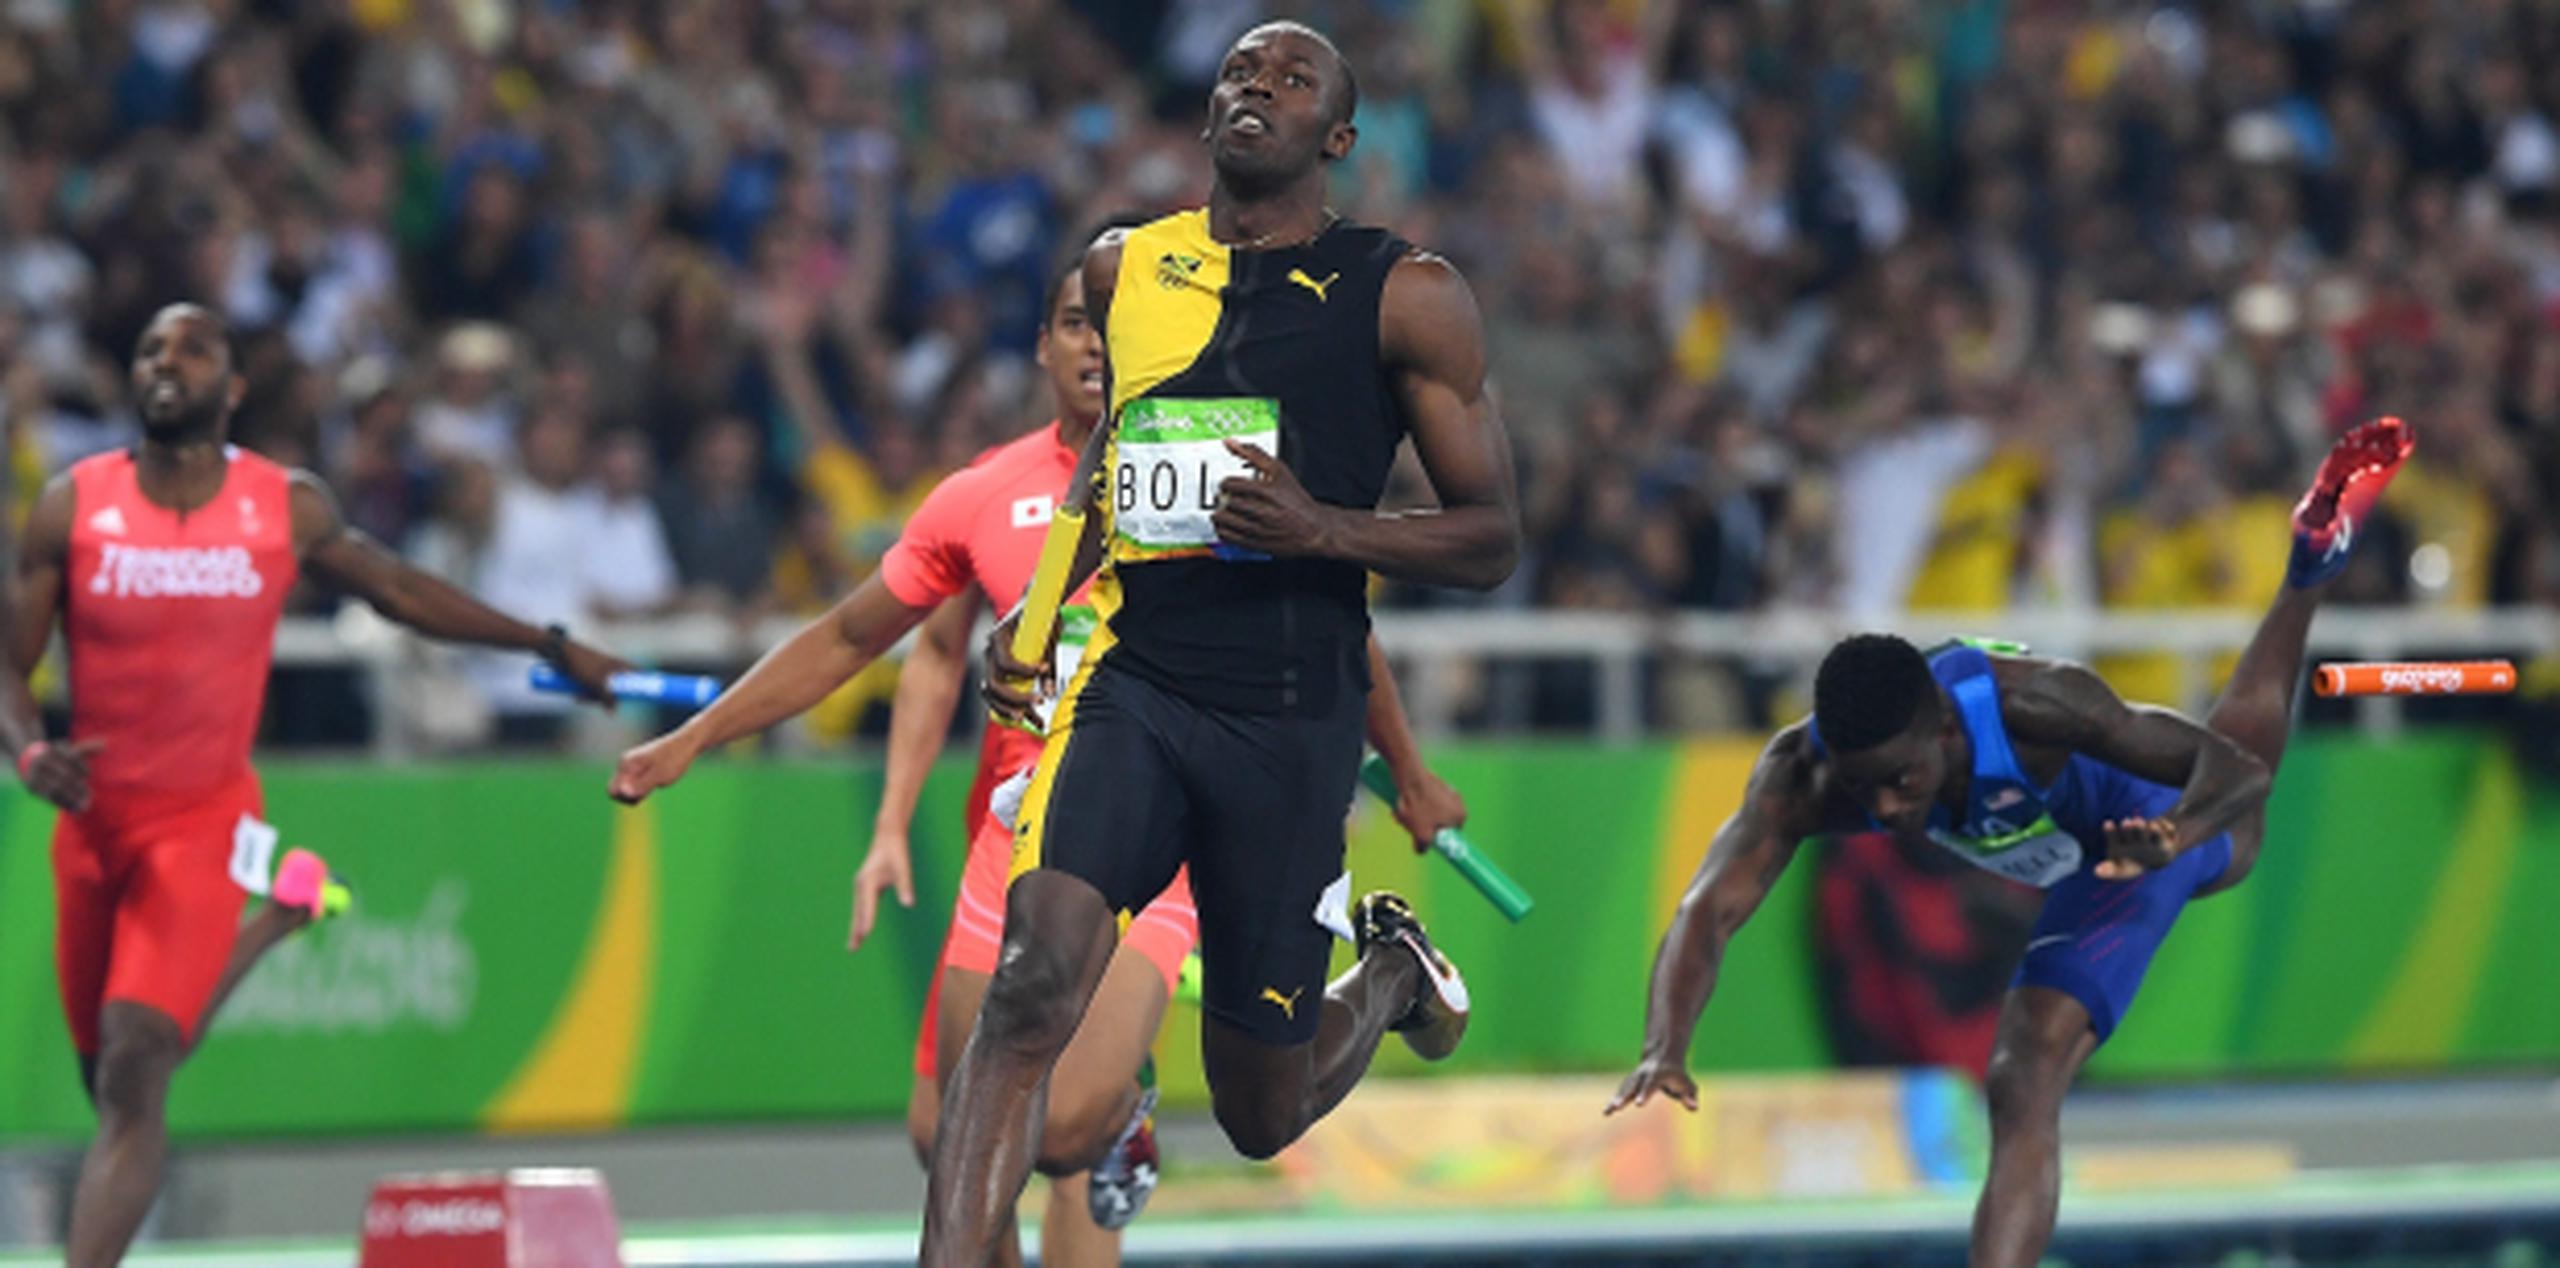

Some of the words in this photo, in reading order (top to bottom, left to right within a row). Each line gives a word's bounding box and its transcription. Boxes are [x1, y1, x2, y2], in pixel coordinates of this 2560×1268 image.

[1117, 459, 1258, 512] BOL
[100, 543, 252, 573] TRINIDAD
[115, 568, 263, 598] TOBAGO
[401, 1200, 503, 1236] OMEGA
